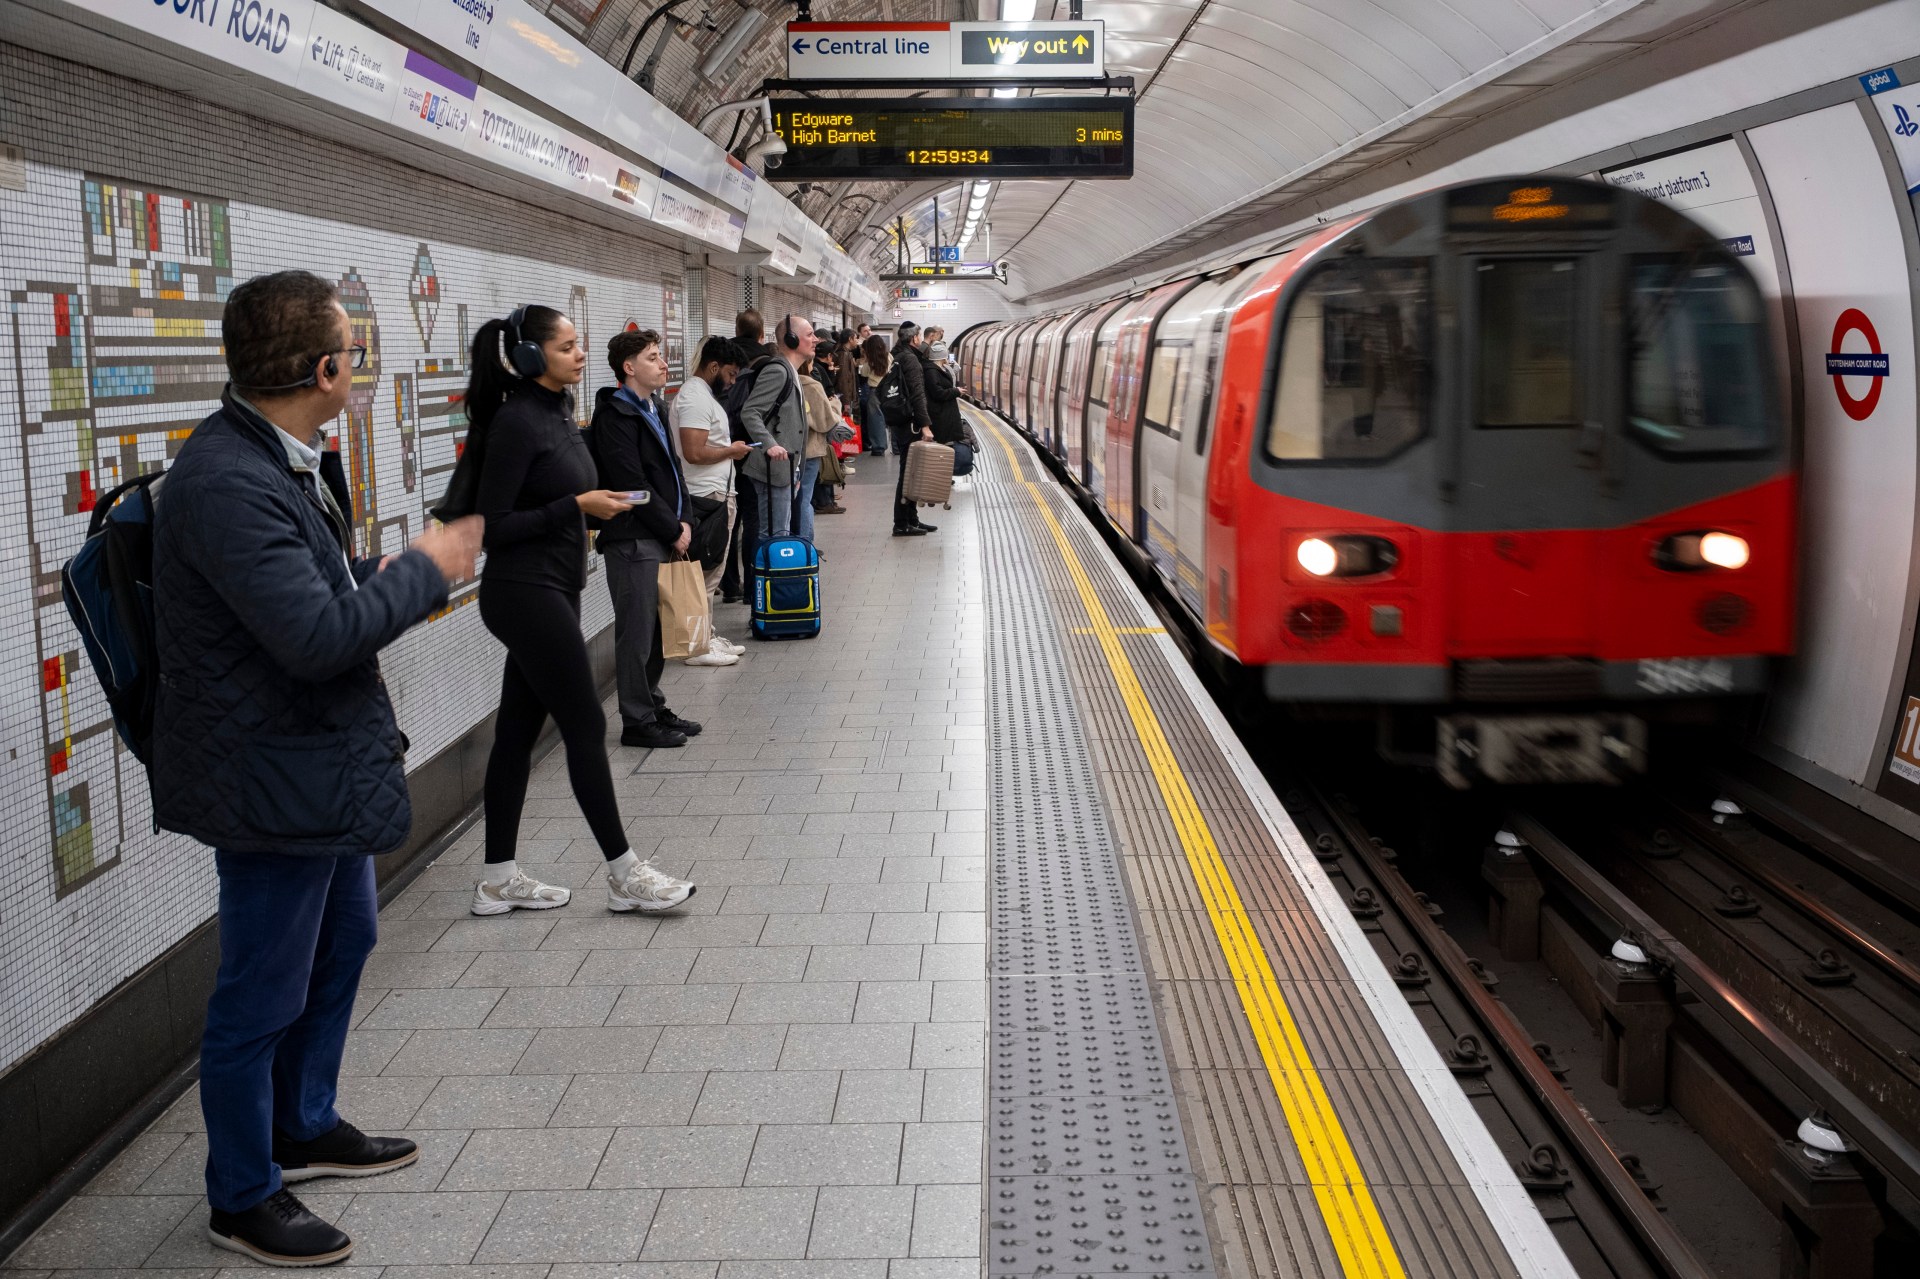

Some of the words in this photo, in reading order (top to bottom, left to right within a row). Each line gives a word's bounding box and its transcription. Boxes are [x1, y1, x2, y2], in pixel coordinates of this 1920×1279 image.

[452, 0, 487, 21] zabeth
[226, 0, 290, 54] ROAD
[466, 24, 480, 50] line
[816, 38, 887, 55] Central
[896, 38, 930, 55] line
[1033, 38, 1068, 54] out
[323, 41, 344, 71] Lift
[360, 54, 372, 69] Exit
[371, 62, 382, 73] and
[356, 70, 375, 88] Central
[374, 79, 385, 93] line
[1868, 72, 1891, 92] global
[445, 105, 461, 130] Lift
[775, 113, 781, 127] 1
[792, 112, 853, 128] Edgware
[479, 109, 541, 160] TOTTENHAM
[538, 137, 570, 172] COURT
[565, 150, 589, 180] ROAD
[792, 130, 822, 145] High
[828, 129, 877, 144] Barnet
[1076, 128, 1086, 143] 3
[1092, 128, 1123, 141] mins
[908, 150, 990, 164] 12:59:34
[1610, 173, 1636, 186] Northern
[1633, 170, 1646, 181] line
[1664, 175, 1704, 201] platform
[1700, 171, 1711, 188] 3
[1737, 239, 1753, 252] Road
[920, 267, 934, 275] Way
[1828, 359, 1856, 368] TOTTENHAM
[1855, 359, 1872, 369] COURT
[1872, 360, 1887, 369] ROAD
